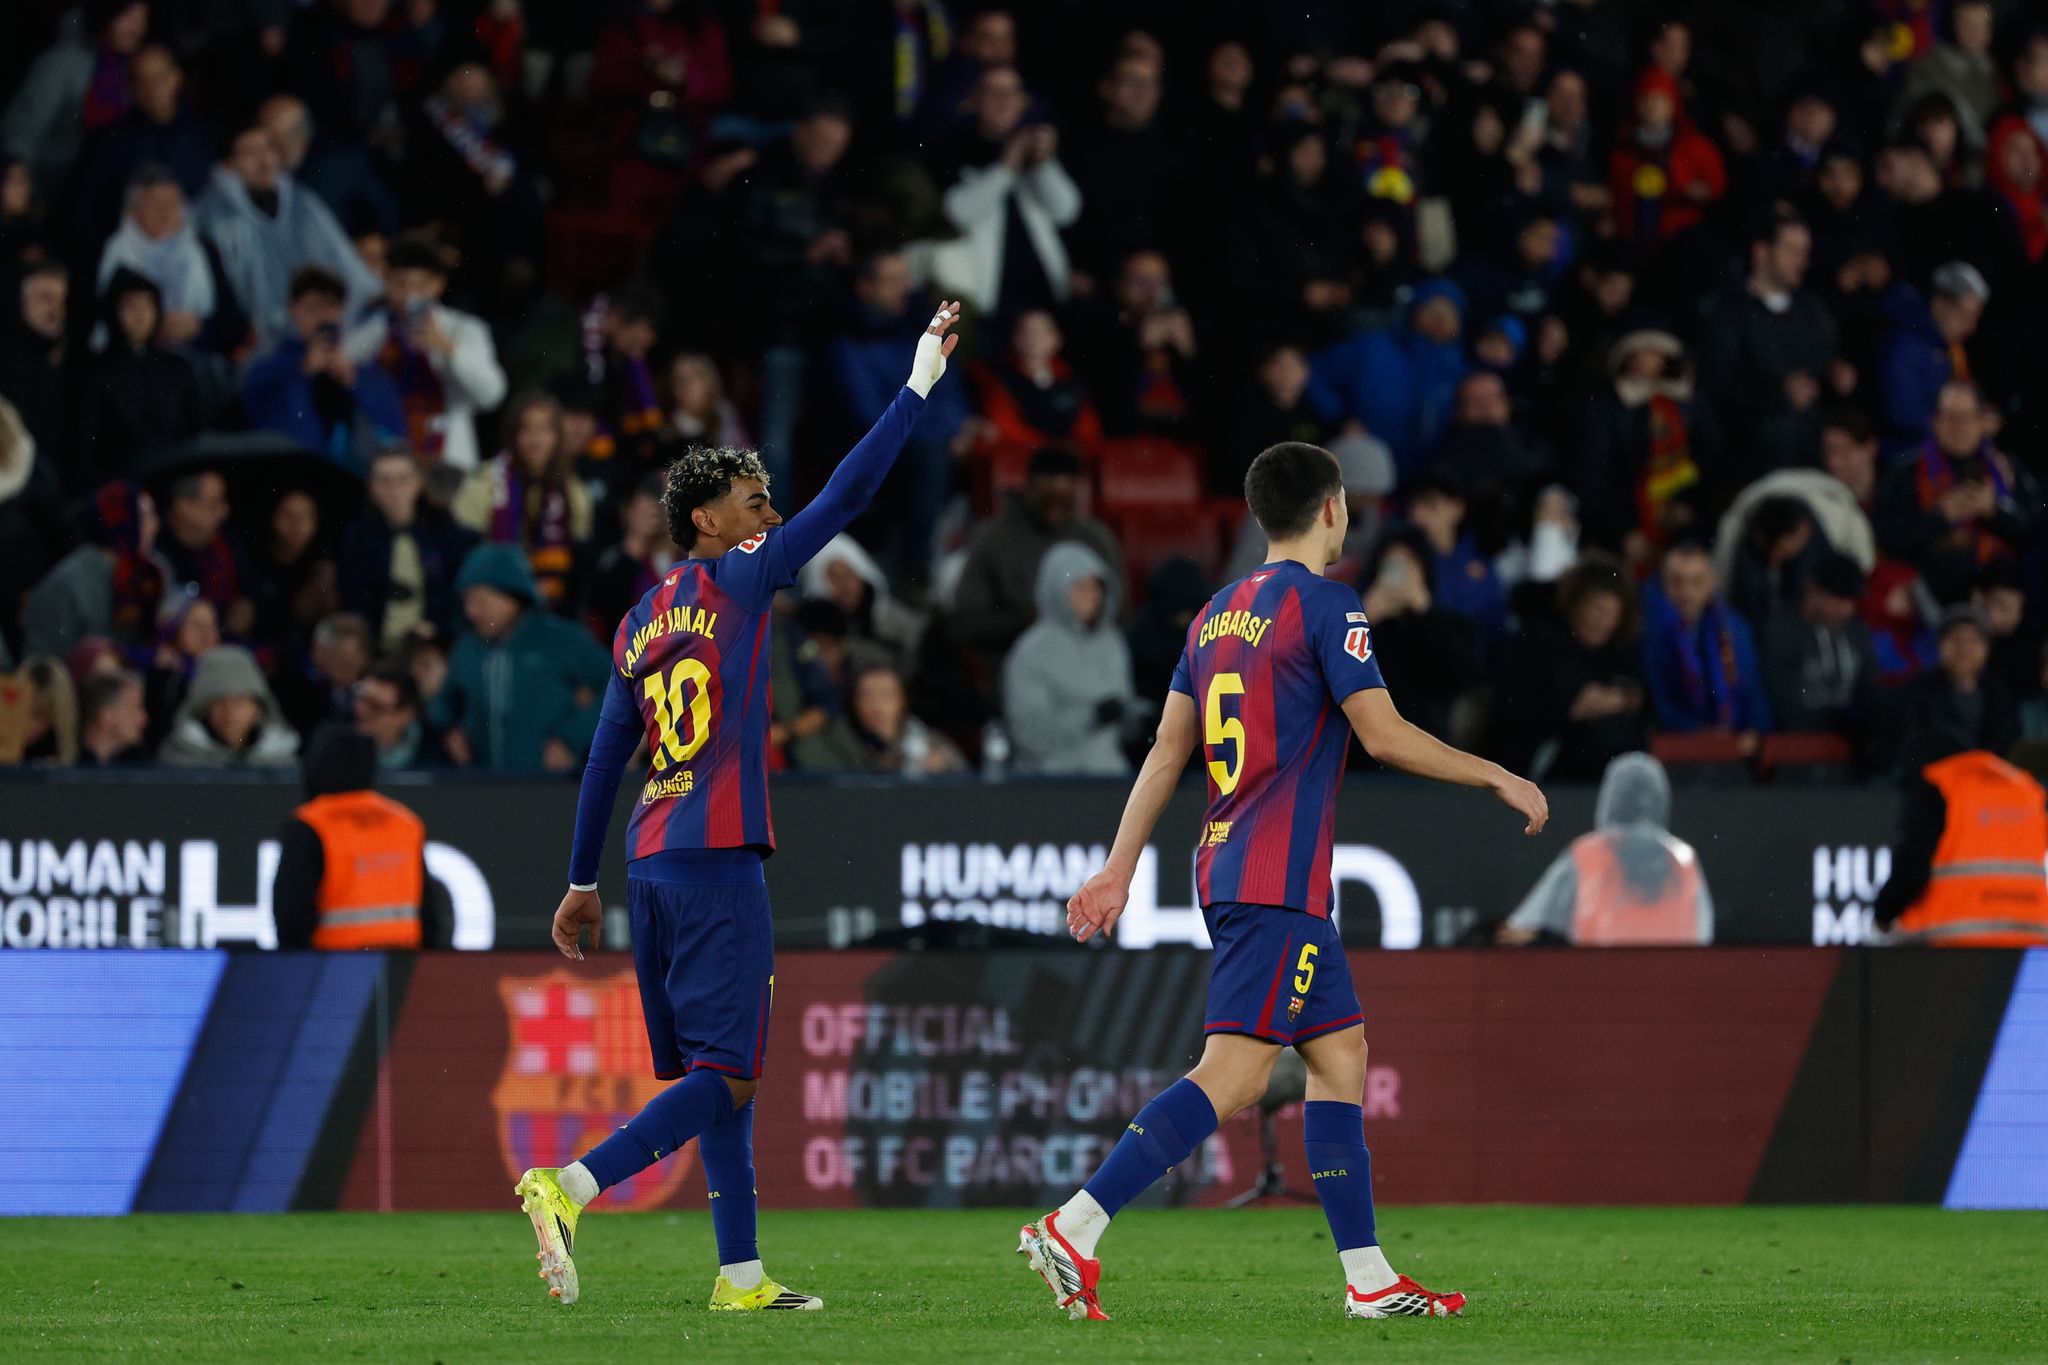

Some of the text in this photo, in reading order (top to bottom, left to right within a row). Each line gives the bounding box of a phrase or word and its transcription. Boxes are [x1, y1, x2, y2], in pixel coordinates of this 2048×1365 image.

[666, 606, 718, 640] YAMAL
[1199, 610, 1272, 648] CUBARSÍ
[643, 658, 712, 771] 10
[1205, 672, 1246, 796] 5
[0, 840, 166, 896] UMAN
[901, 842, 1108, 900] HUMAN
[0, 897, 163, 949] OBILE
[1294, 943, 1318, 994] 5
[803, 1069, 992, 1121] MOBILE
